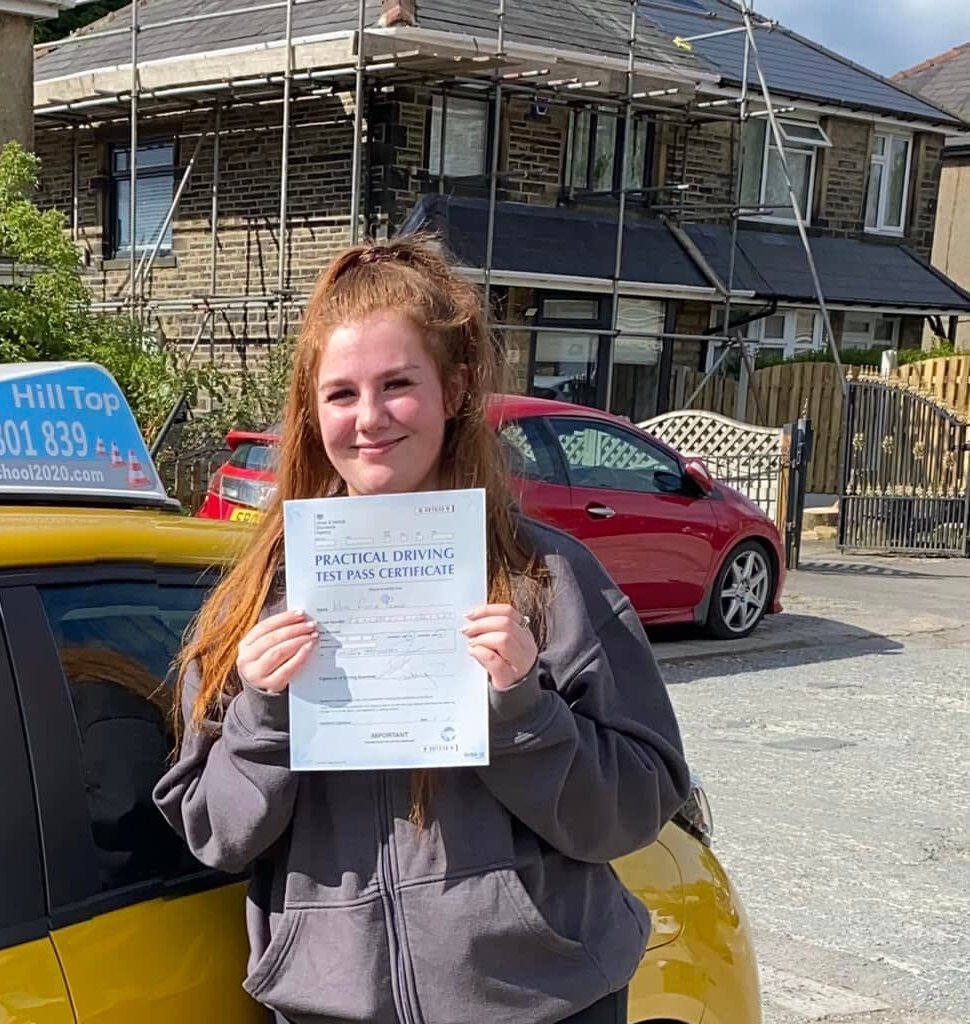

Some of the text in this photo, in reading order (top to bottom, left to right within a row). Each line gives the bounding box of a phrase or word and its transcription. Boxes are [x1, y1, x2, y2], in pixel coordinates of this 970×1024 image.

[11, 383, 120, 416] Hill Top
[41, 420, 88, 457] 839
[315, 548, 454, 566] PRACTICAL DRIVING
[315, 564, 454, 582] TEST PASS CERTIFICATE
